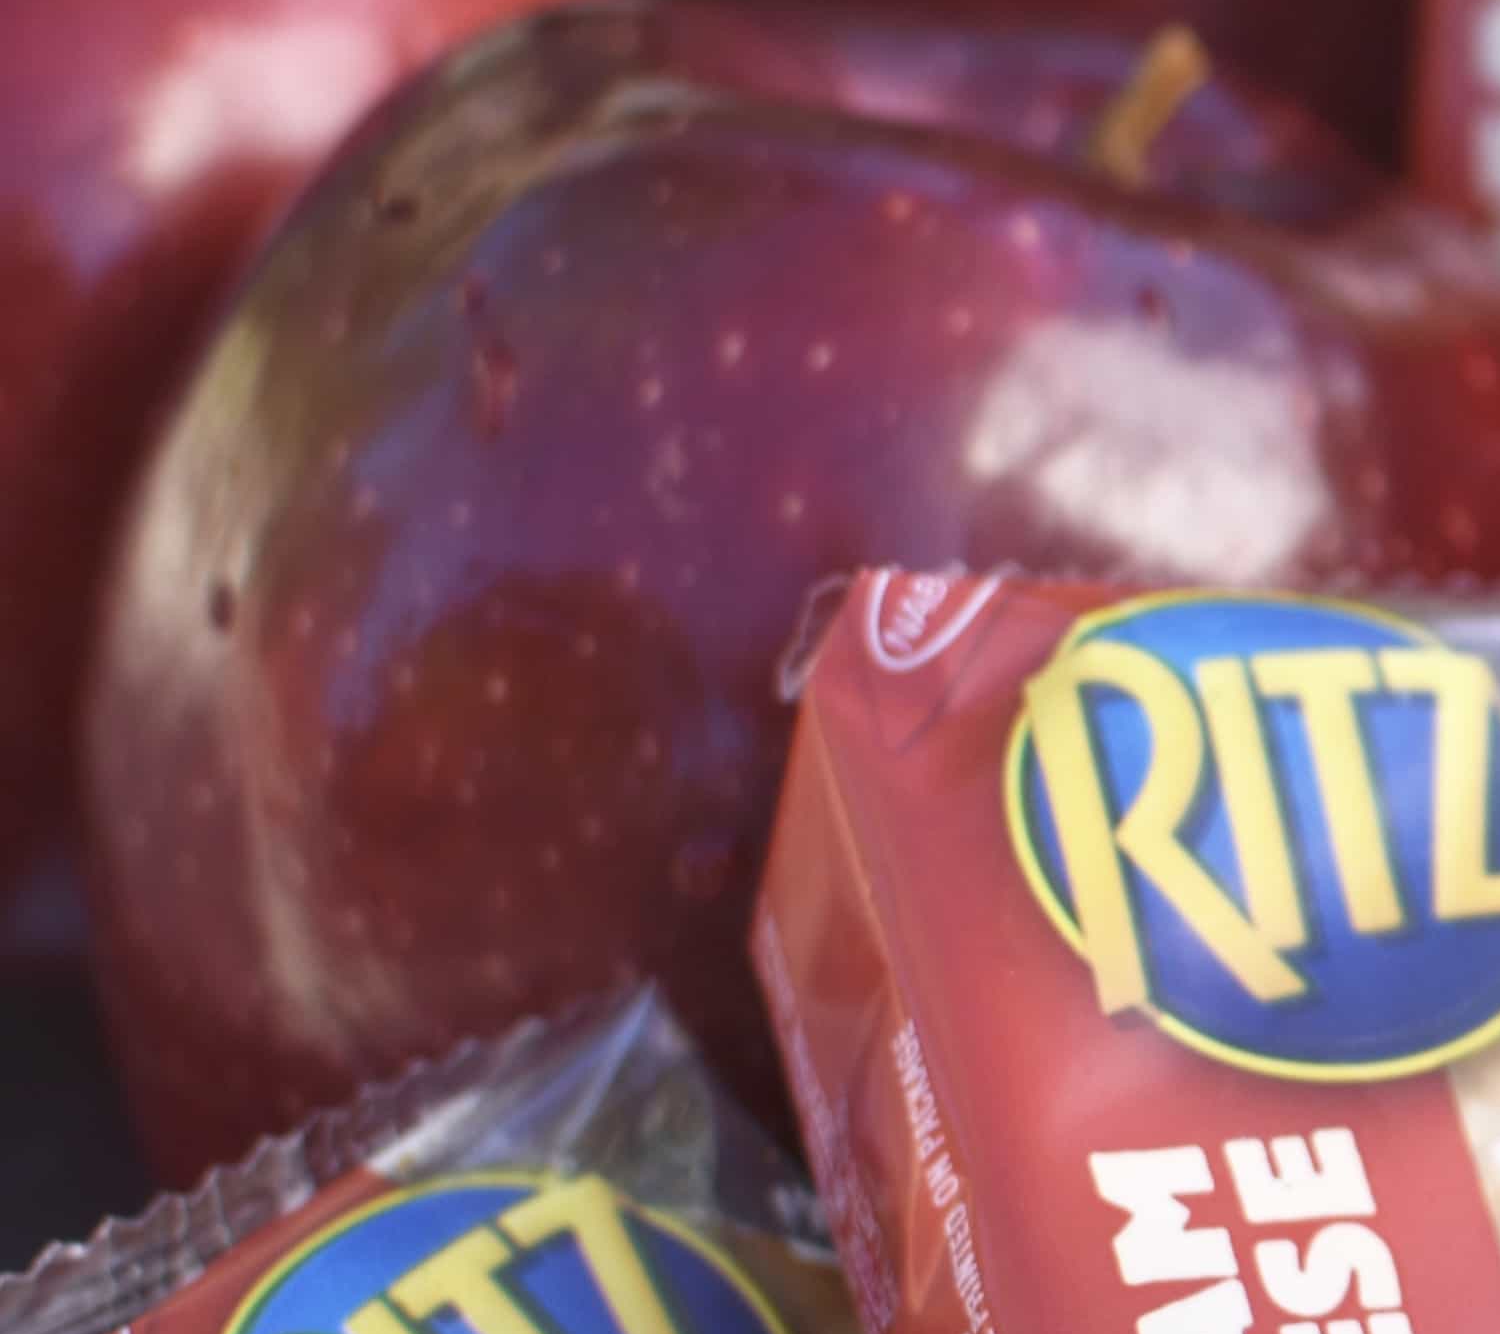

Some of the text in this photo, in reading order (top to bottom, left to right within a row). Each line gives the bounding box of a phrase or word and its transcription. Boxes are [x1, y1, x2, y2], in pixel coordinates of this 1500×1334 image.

[890, 1017, 945, 1159] PACKAGE
[924, 1152, 959, 1208] ON
[940, 1202, 991, 1330] PRINTED
